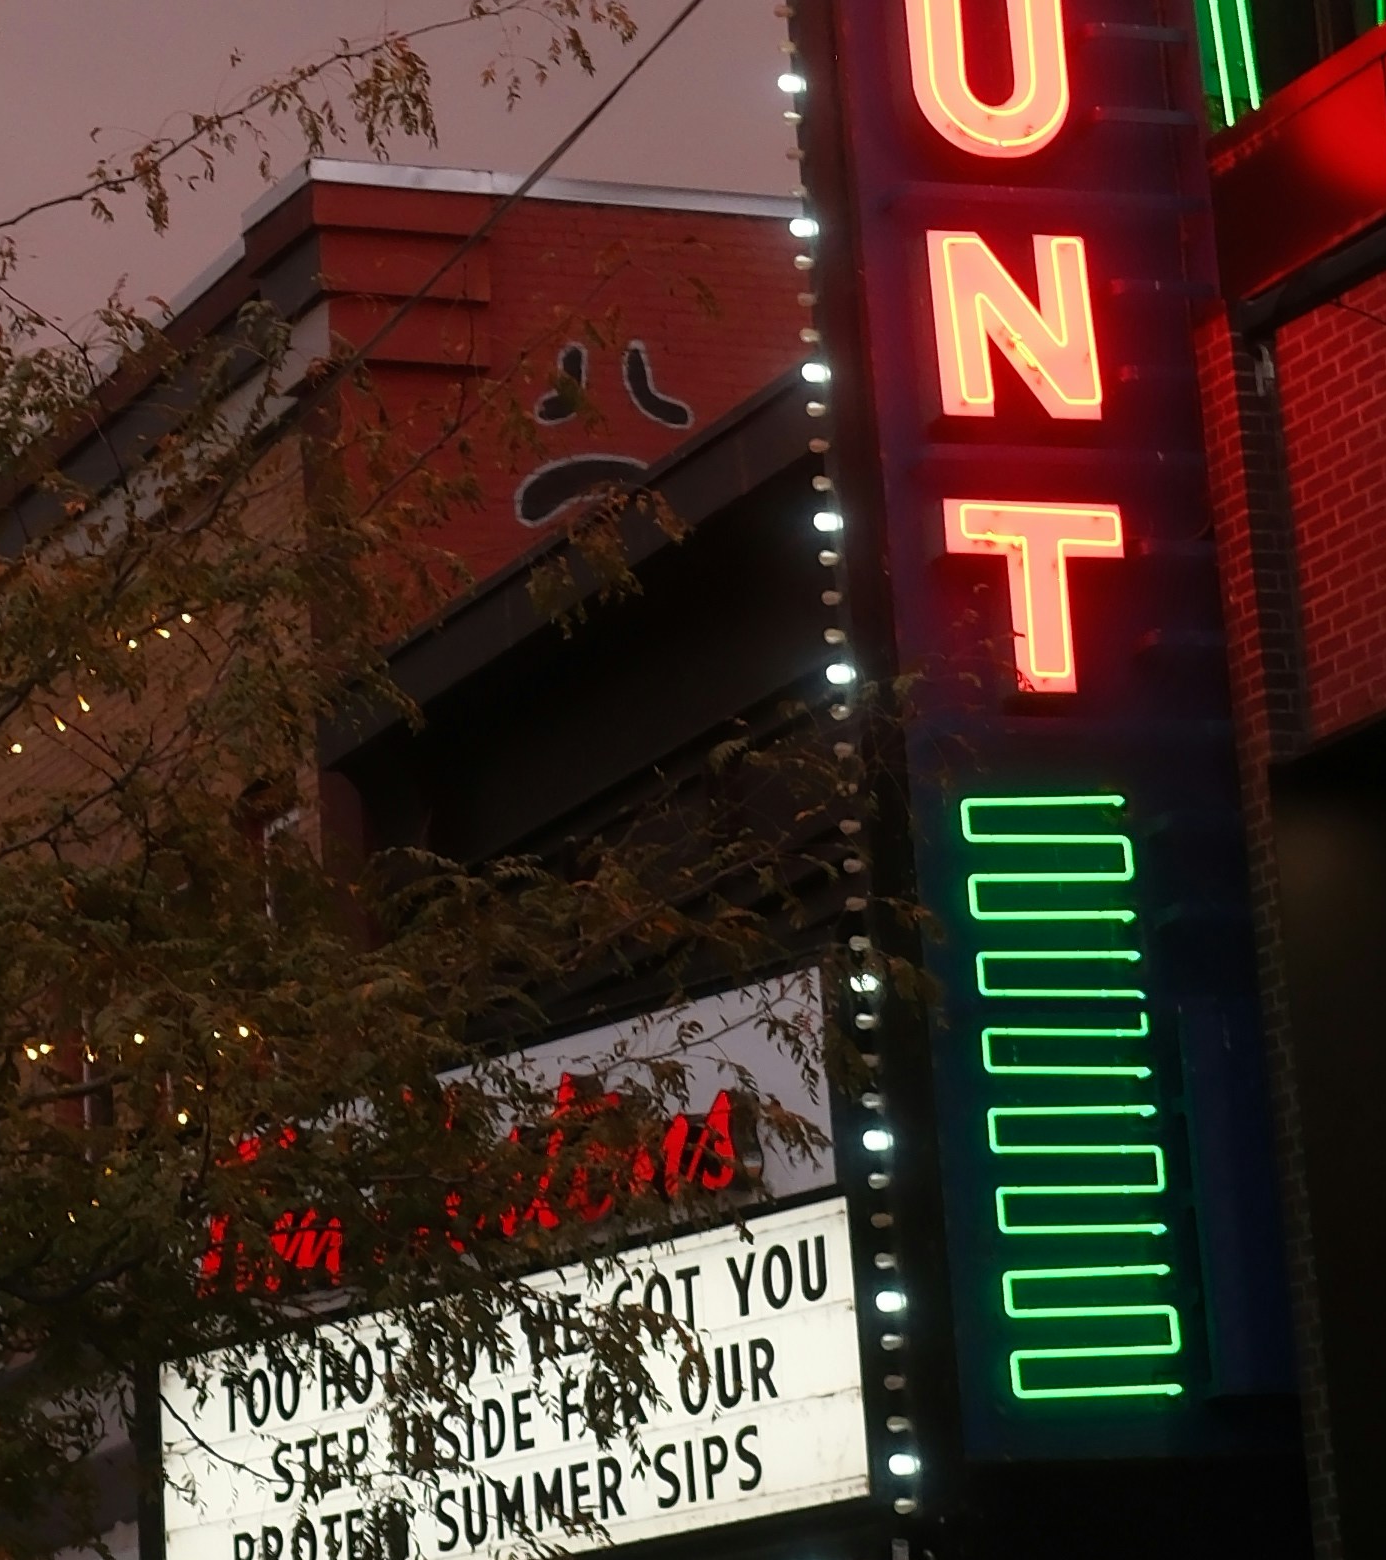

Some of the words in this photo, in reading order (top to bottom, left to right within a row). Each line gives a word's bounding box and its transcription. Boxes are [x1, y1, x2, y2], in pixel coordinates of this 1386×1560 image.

[220, 1363, 301, 1432] TOO
[726, 1234, 828, 1317] YOU
[270, 1425, 370, 1503] STEP
[393, 1389, 536, 1474] SIDE
[678, 1337, 778, 1417] OUR
[434, 1456, 627, 1553] SUMMER
[653, 1424, 763, 1510] SIPS
